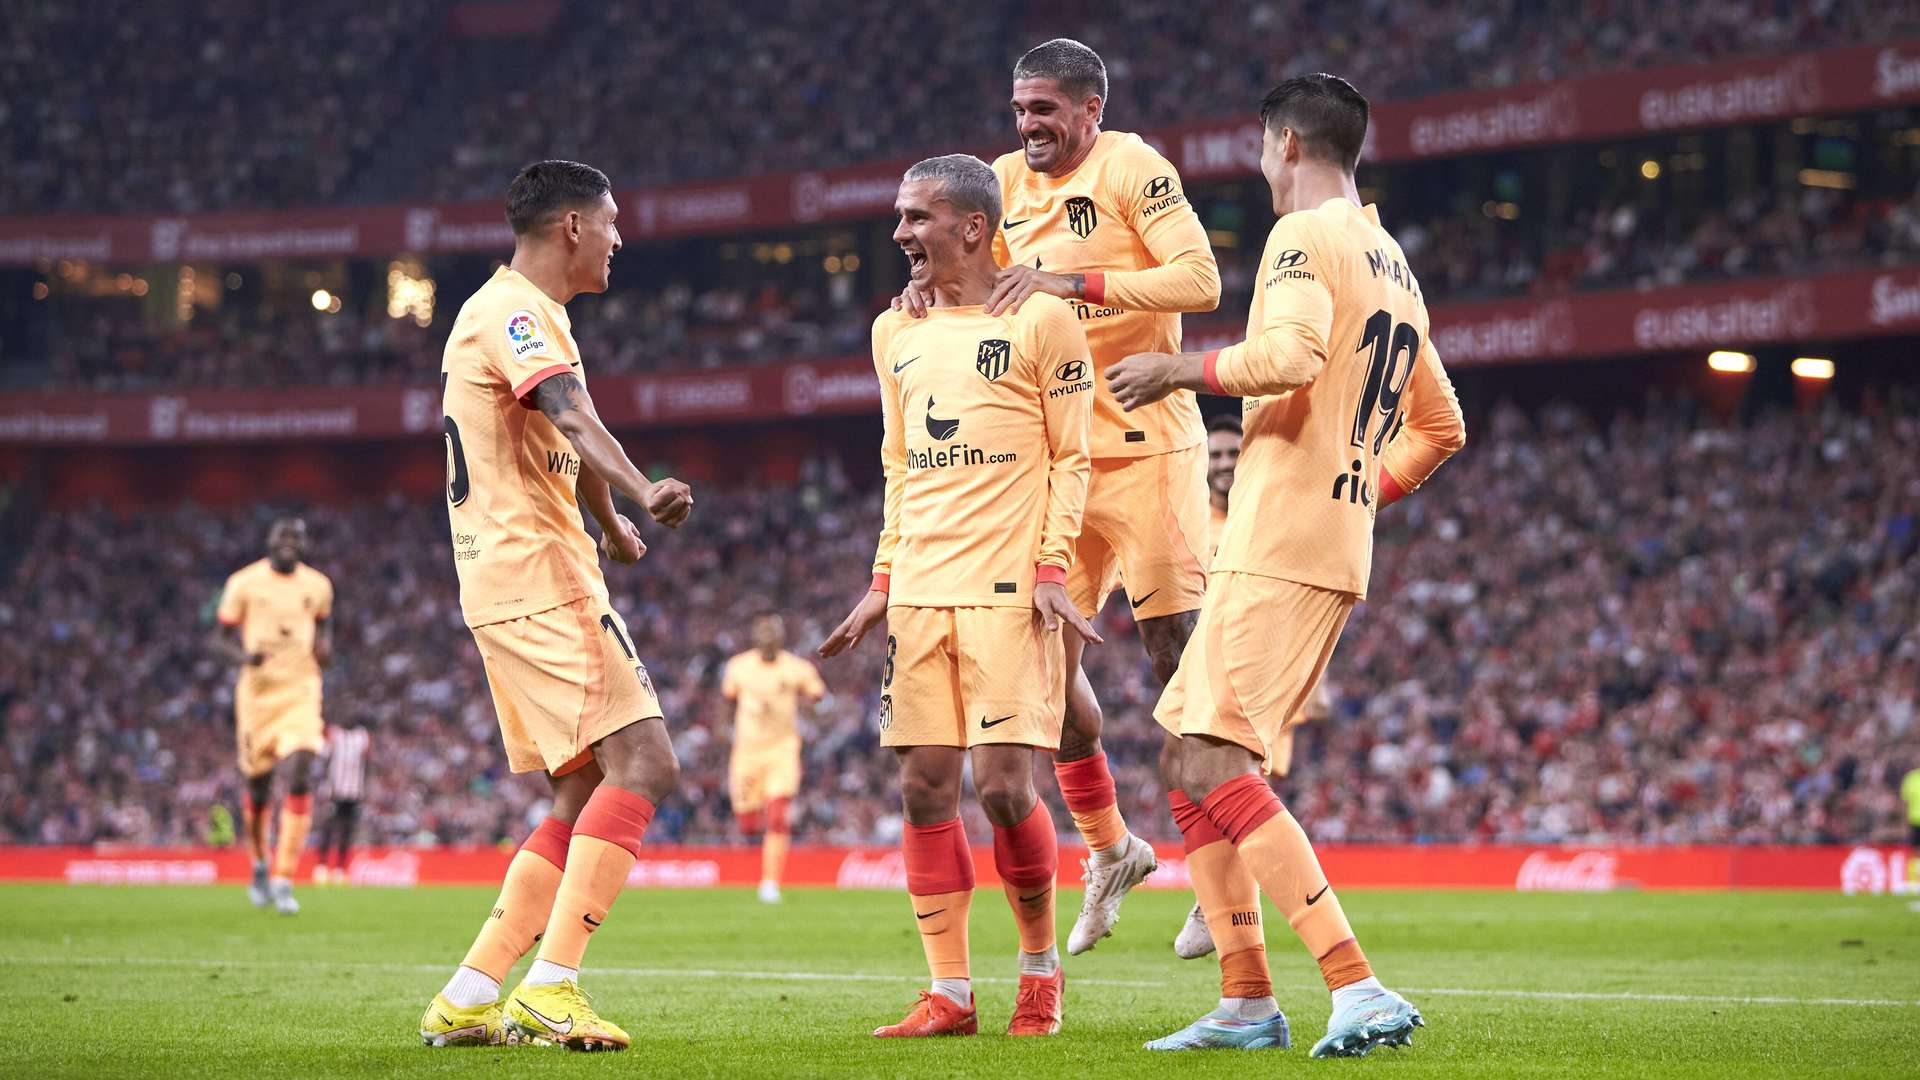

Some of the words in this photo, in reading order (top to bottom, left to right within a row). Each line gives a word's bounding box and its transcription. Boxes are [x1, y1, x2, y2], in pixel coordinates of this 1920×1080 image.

[1142, 194, 1185, 218] HYUNDAI
[1266, 270, 1315, 290] HYUNDAI
[516, 341, 544, 355] LaLiga
[1049, 380, 1094, 399] HYUNDAI
[1350, 309, 1420, 456] 19
[1231, 911, 1259, 926] ATLETI
